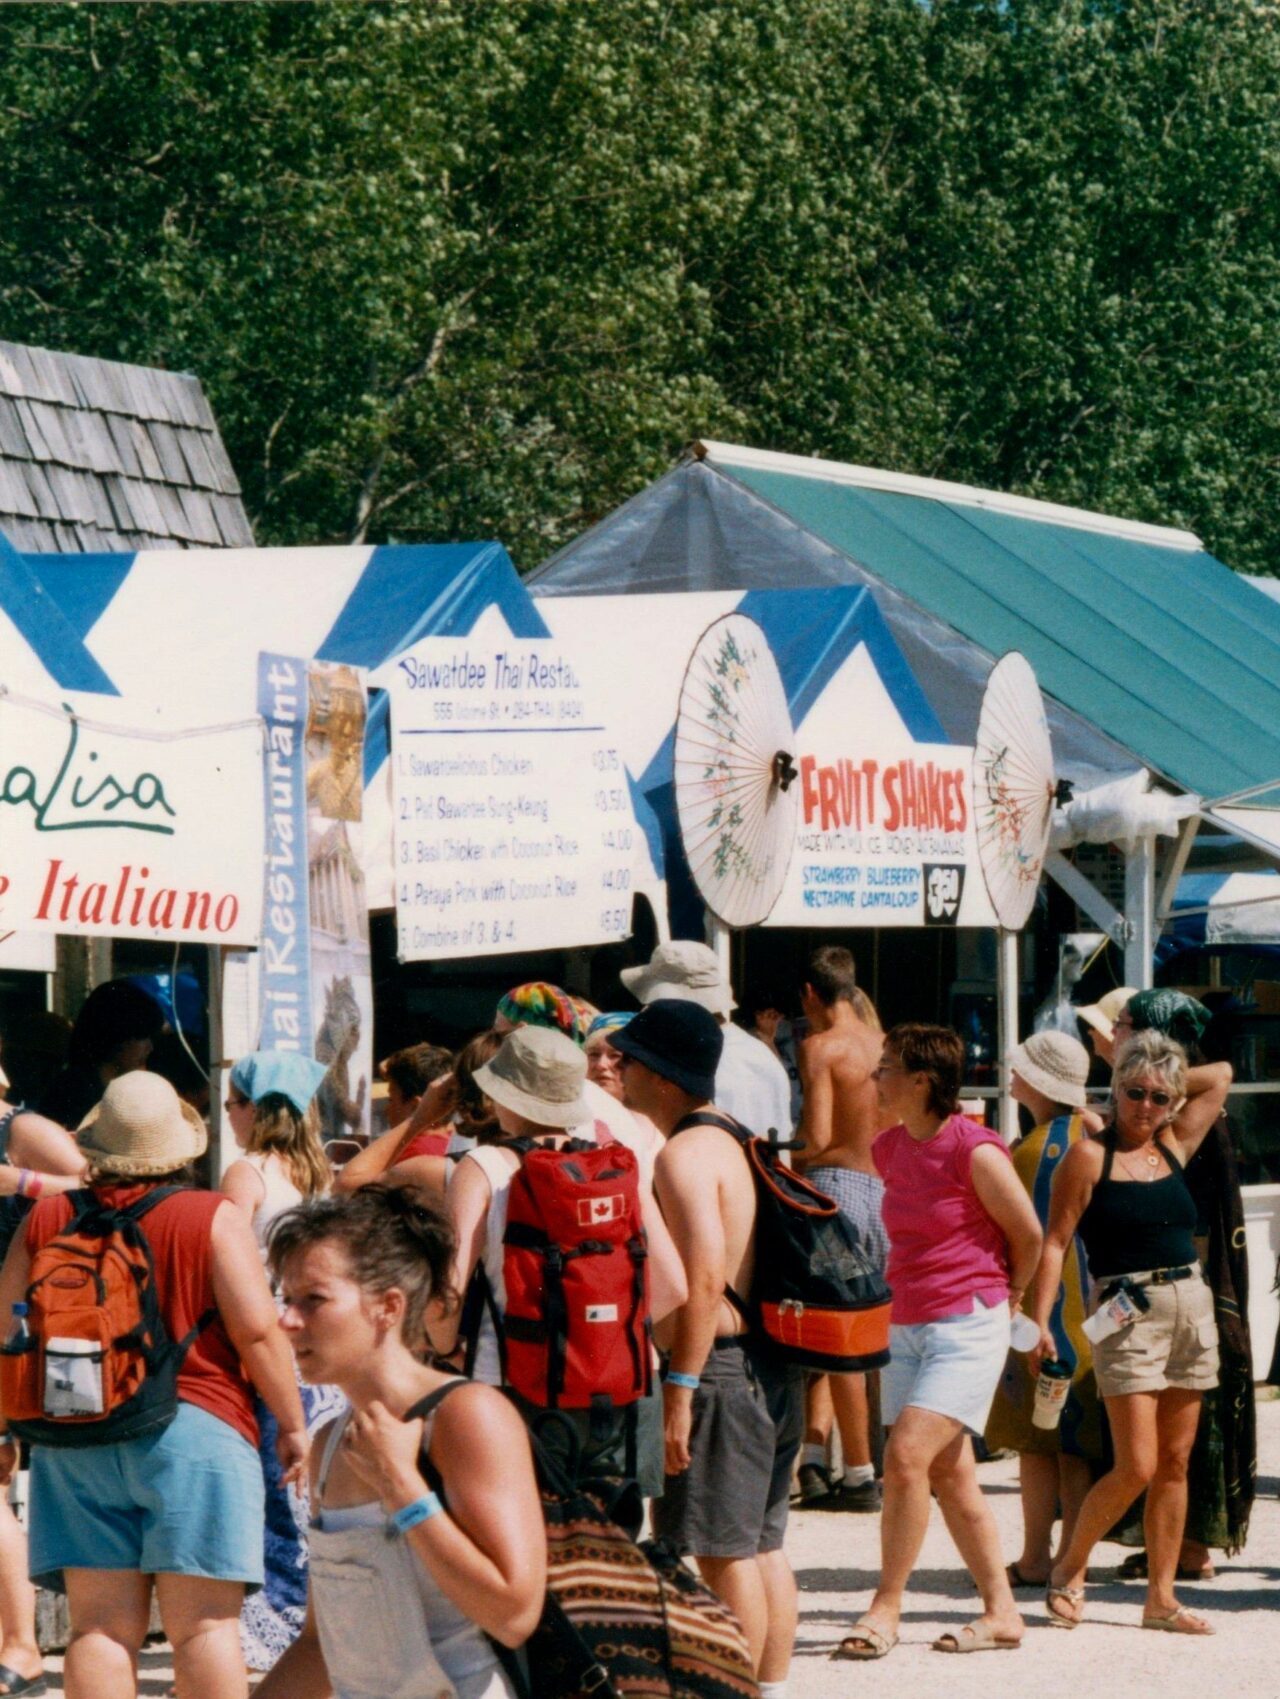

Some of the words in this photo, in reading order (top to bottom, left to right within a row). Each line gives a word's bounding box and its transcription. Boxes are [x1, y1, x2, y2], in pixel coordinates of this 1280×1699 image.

[398, 651, 487, 690] Sawatdee
[494, 651, 526, 690] Thai
[0, 702, 176, 835] aLisa
[800, 754, 879, 832] FRUIT
[882, 757, 968, 834] SHAKES
[263, 661, 298, 976] Restaurant
[33, 858, 240, 933] Italiano
[802, 864, 861, 886] STRAWBERRY
[866, 866, 922, 888] BLUEBERRY
[802, 888, 857, 909] NECTARINE
[861, 890, 920, 910] CANTALOUP
